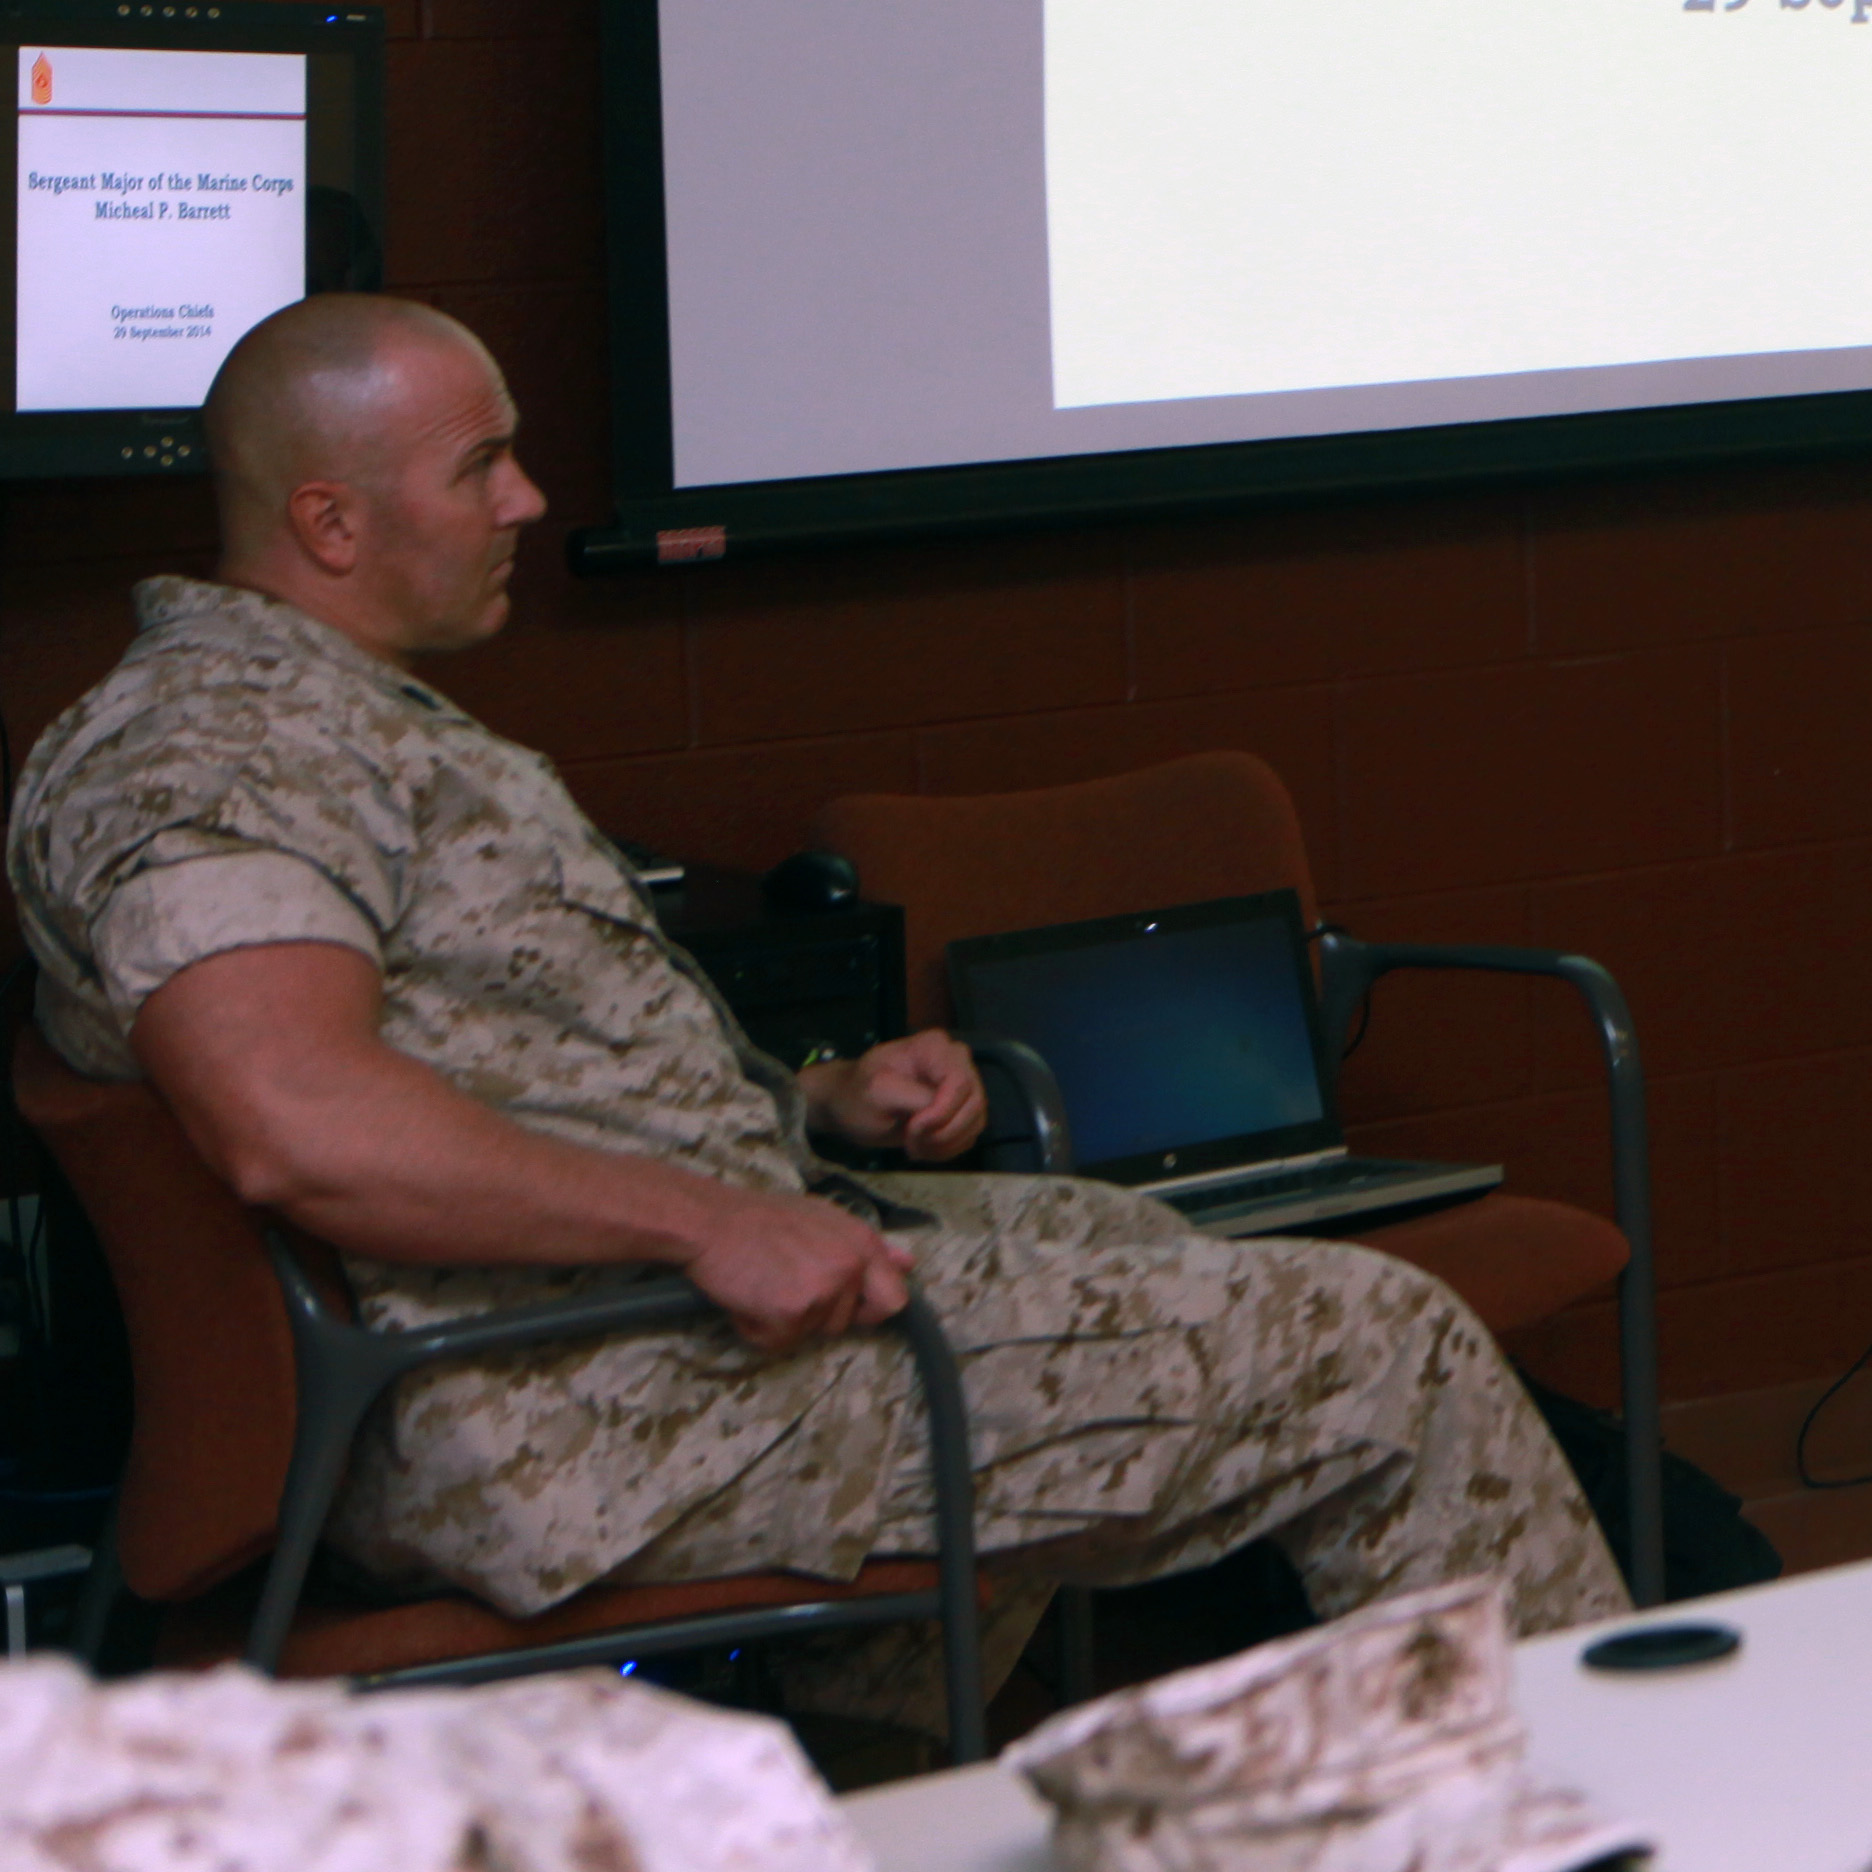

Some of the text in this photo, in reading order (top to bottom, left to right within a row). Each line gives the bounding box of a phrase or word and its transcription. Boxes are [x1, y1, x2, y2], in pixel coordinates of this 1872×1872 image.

[28, 172, 295, 196] Sergeant Major of the Marine Corps
[95, 201, 231, 220] Micheal P. Barrett
[111, 305, 175, 322] Operations
